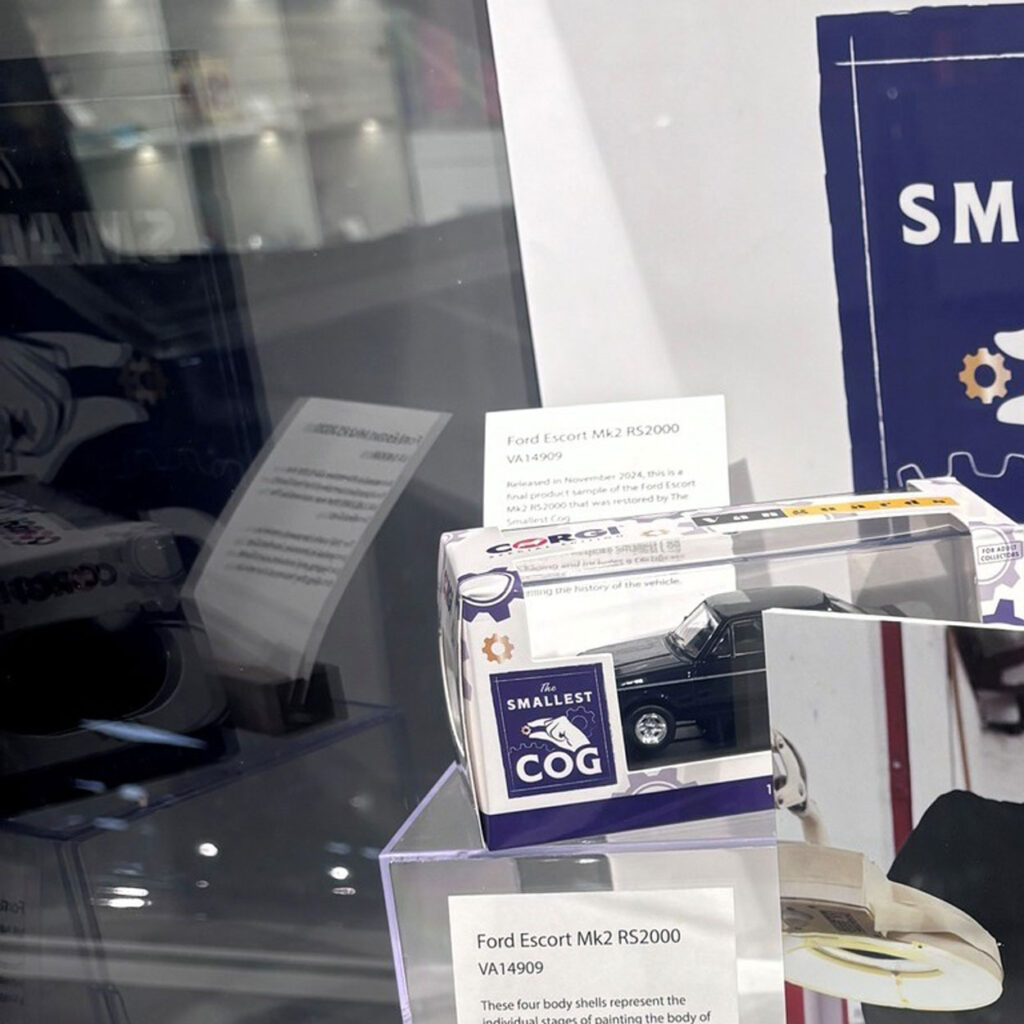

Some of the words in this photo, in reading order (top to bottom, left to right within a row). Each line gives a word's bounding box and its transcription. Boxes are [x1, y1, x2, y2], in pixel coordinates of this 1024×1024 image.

[507, 433, 539, 445] Ford
[543, 431, 586, 443] Escort
[592, 428, 621, 438] Mk2
[626, 423, 680, 436] RS2000
[506, 451, 562, 464] VA14909
[506, 478, 550, 488] Released
[564, 474, 615, 483] November
[619, 471, 644, 480] 2024,
[506, 492, 528, 500] final
[529, 489, 569, 500] product
[572, 487, 607, 496] sample
[609, 484, 620, 493] of
[640, 481, 663, 490] Ford
[665, 480, 695, 489] Escort
[529, 502, 567, 510] RS2000
[568, 500, 589, 508] that
[612, 494, 654, 504] restored
[656, 494, 668, 503] by
[670, 492, 688, 500] The
[485, 526, 620, 554] CORGI
[997, 544, 1017, 552] ADULT
[980, 551, 1020, 562] COLLECTORS
[539, 682, 557, 693] The
[506, 691, 593, 711] SMALLEST
[515, 746, 602, 784] COG
[477, 932, 515, 949] Ford
[520, 932, 572, 948] Escort
[577, 929, 612, 946] Mk2
[617, 928, 681, 944] RS2000
[478, 960, 544, 975] VA14909
[480, 999, 514, 1011] These
[516, 998, 540, 1010] four
[542, 997, 573, 1011] body
[575, 996, 607, 1008] shells
[609, 996, 664, 1009] represent
[666, 994, 686, 1006] the
[579, 1014, 592, 1024] of
[644, 1012, 664, 1024] the
[666, 1011, 697, 1024] body
[699, 1010, 711, 1022] of
